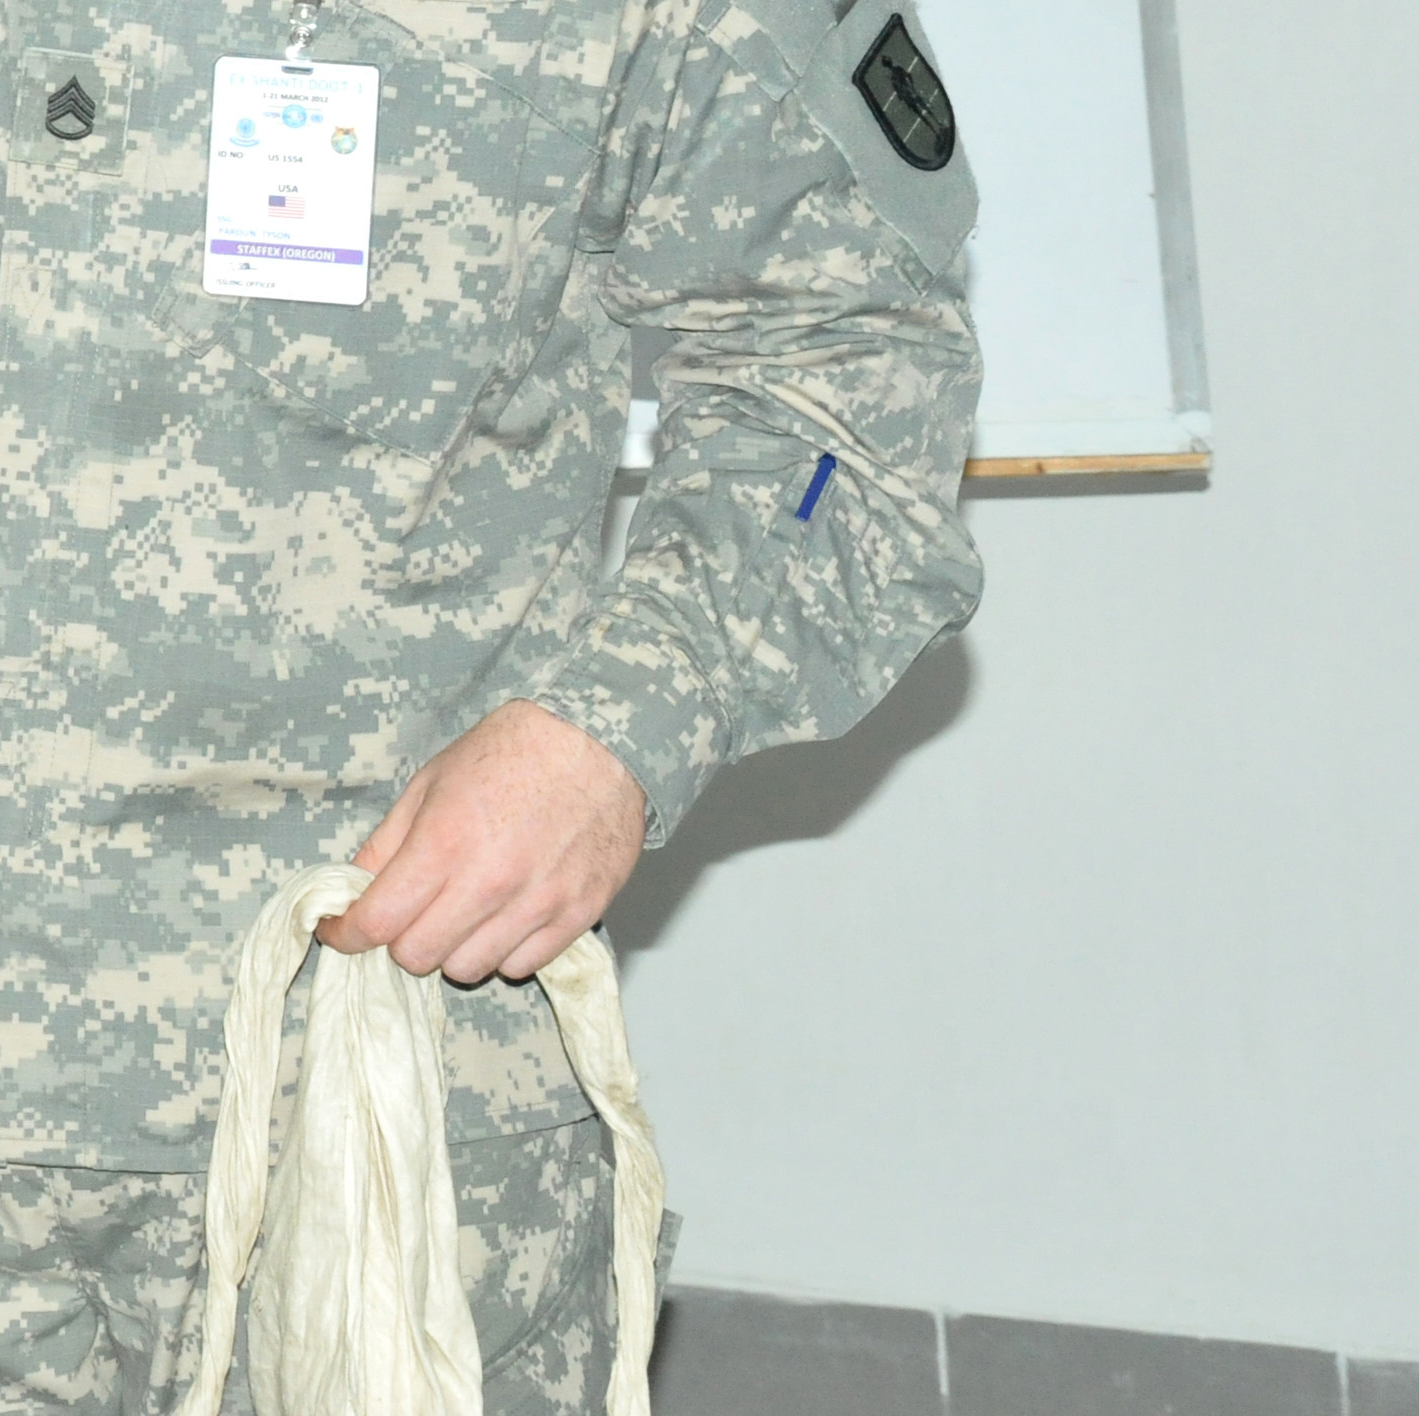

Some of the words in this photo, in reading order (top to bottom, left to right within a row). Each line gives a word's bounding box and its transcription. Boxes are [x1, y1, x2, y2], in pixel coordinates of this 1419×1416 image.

[280, 93, 308, 101] MARCH
[283, 155, 303, 163] 1554
[278, 184, 299, 193] USA
[236, 244, 281, 257] STAFFEX
[282, 246, 336, 262] (OREGON)
